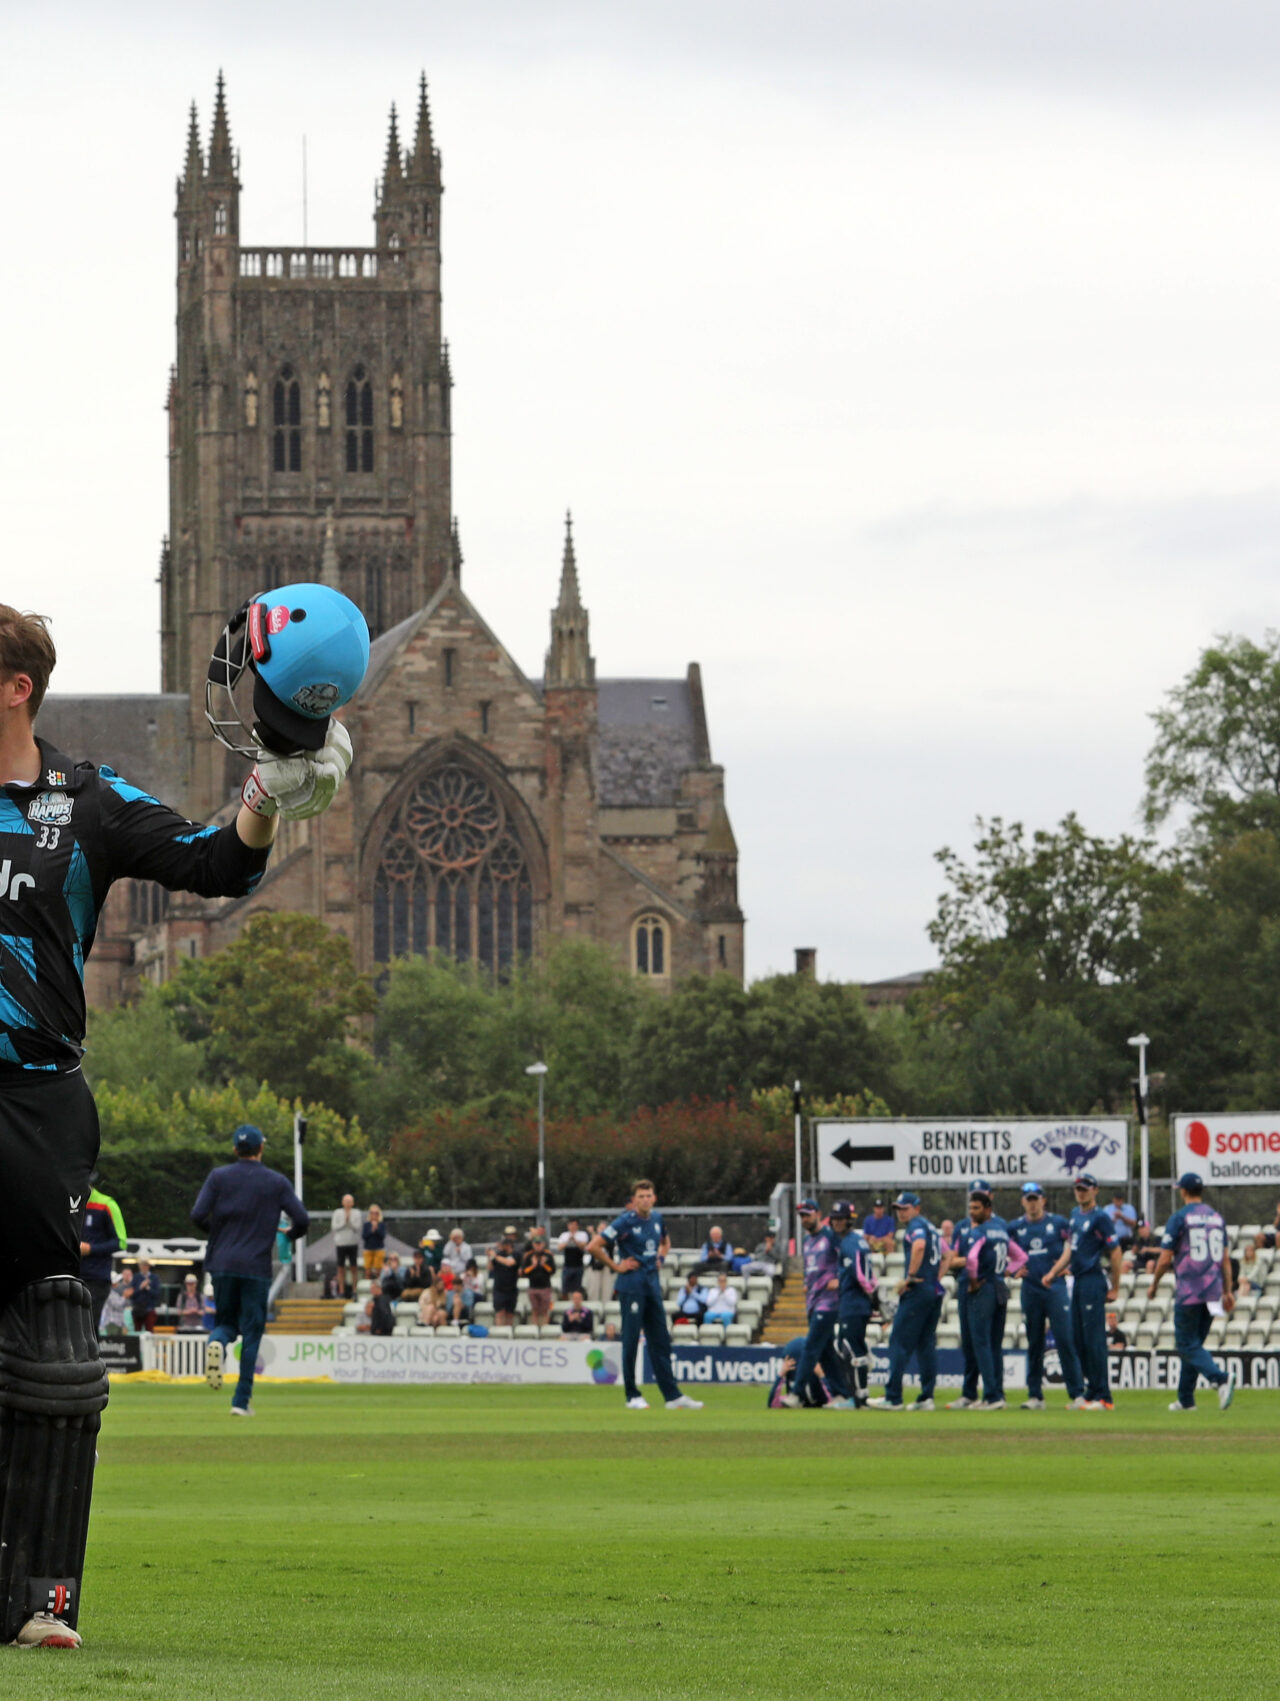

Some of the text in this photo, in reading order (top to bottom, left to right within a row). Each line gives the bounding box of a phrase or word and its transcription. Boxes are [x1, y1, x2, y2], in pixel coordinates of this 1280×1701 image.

[30, 802, 71, 819] RAPIDS
[36, 825, 60, 850] 33
[923, 1131, 1012, 1151] BENNETTS
[1030, 1125, 1121, 1156] BENNETTS
[909, 1154, 1029, 1175] FOOD VILLAGE
[1189, 1228, 1225, 1262] 56
[333, 1368, 358, 1379] Your
[362, 1367, 406, 1380] Trusted
[409, 1368, 469, 1381] Insurance
